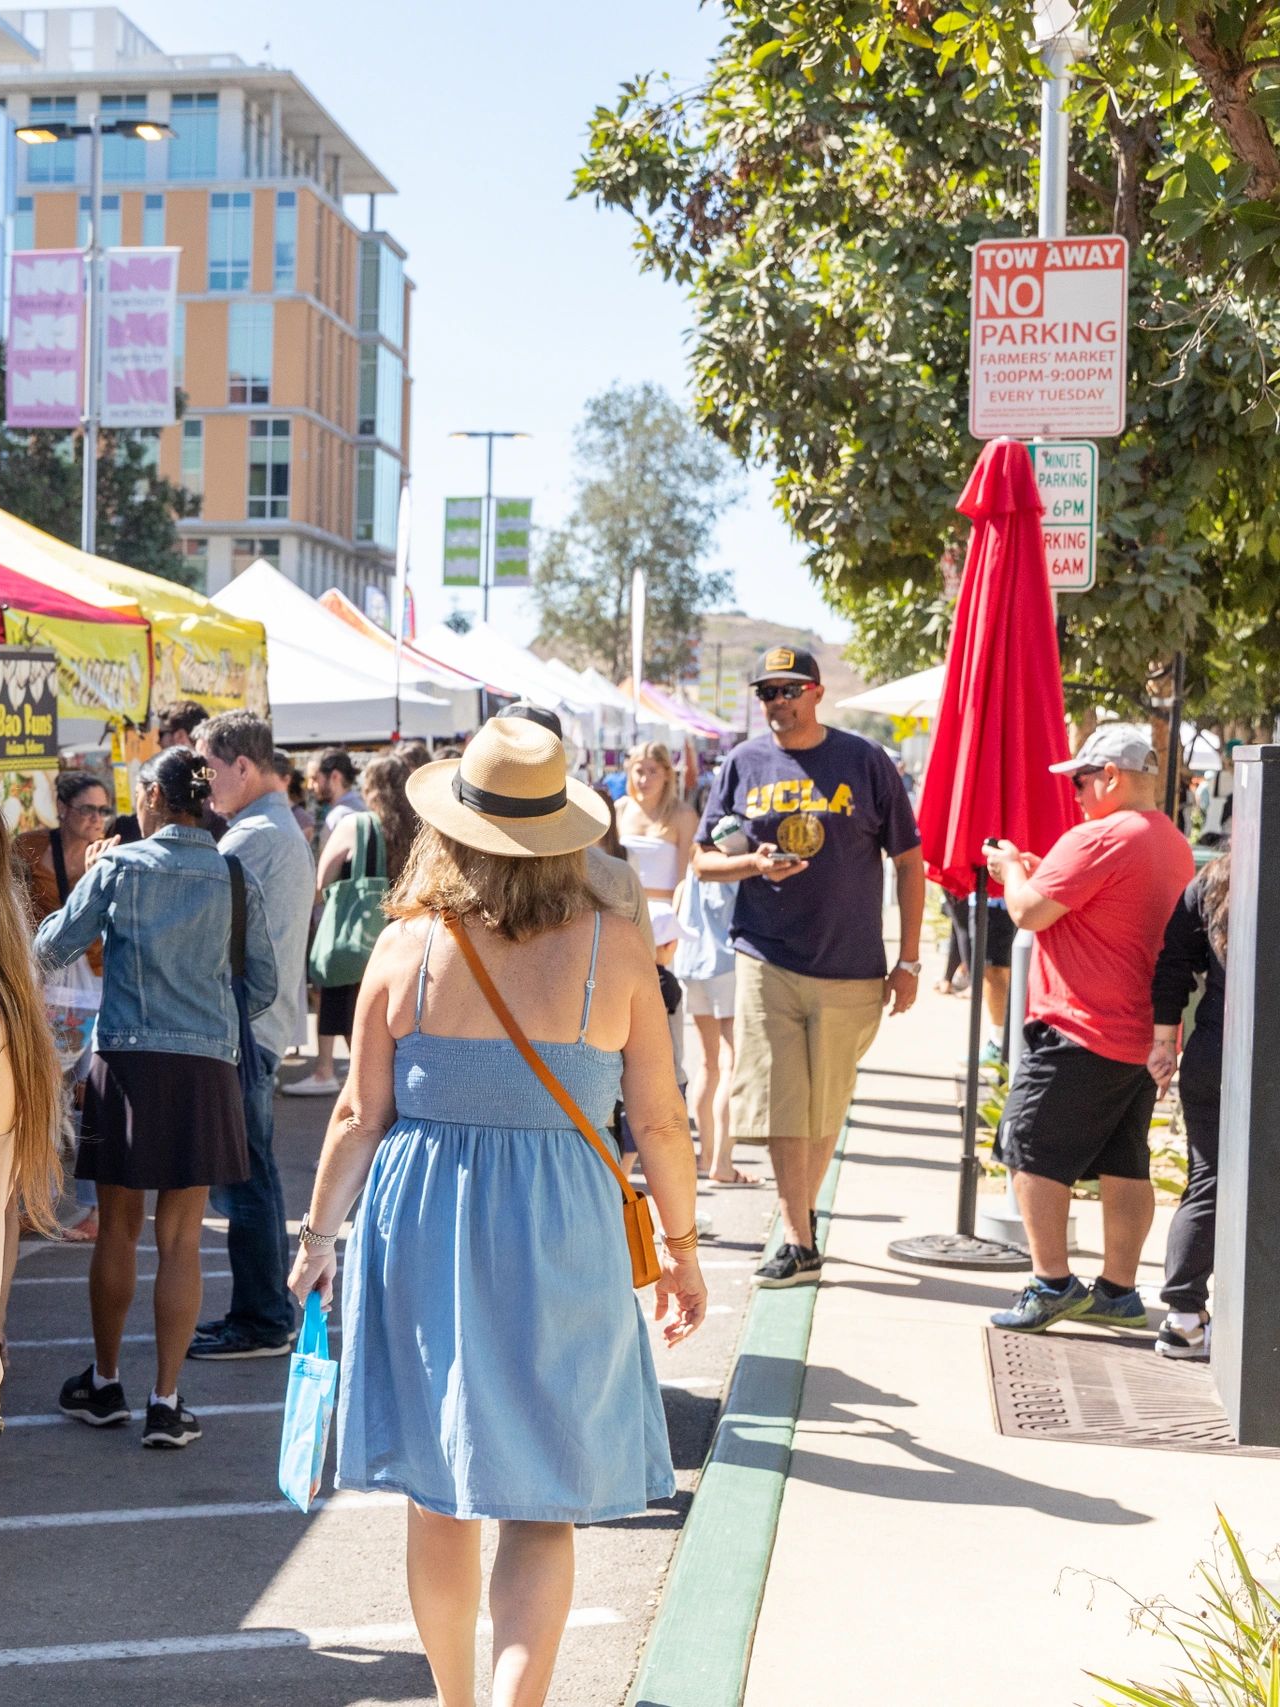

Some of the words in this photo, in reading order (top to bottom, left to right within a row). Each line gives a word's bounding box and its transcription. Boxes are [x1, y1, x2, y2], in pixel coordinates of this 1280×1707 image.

[979, 249, 1037, 270] TOW
[1044, 244, 1120, 267] AWAY
[979, 275, 1041, 317] NO
[980, 321, 1117, 346] PARKING
[980, 351, 1050, 365] FARMERS'
[1054, 350, 1115, 364] MARKET
[983, 368, 1113, 384] 1:00PM-9:00PM
[989, 390, 1034, 403] EVERY
[1039, 388, 1105, 401] TUESDAY
[1043, 453, 1081, 469] MINUTE
[1038, 473, 1087, 489] PARKING
[1052, 500, 1085, 517] 6PM
[1043, 533, 1086, 549] RKING
[1051, 558, 1084, 575] 6AM
[23, 703, 53, 737] Buns
[745, 779, 853, 819] UCLA
